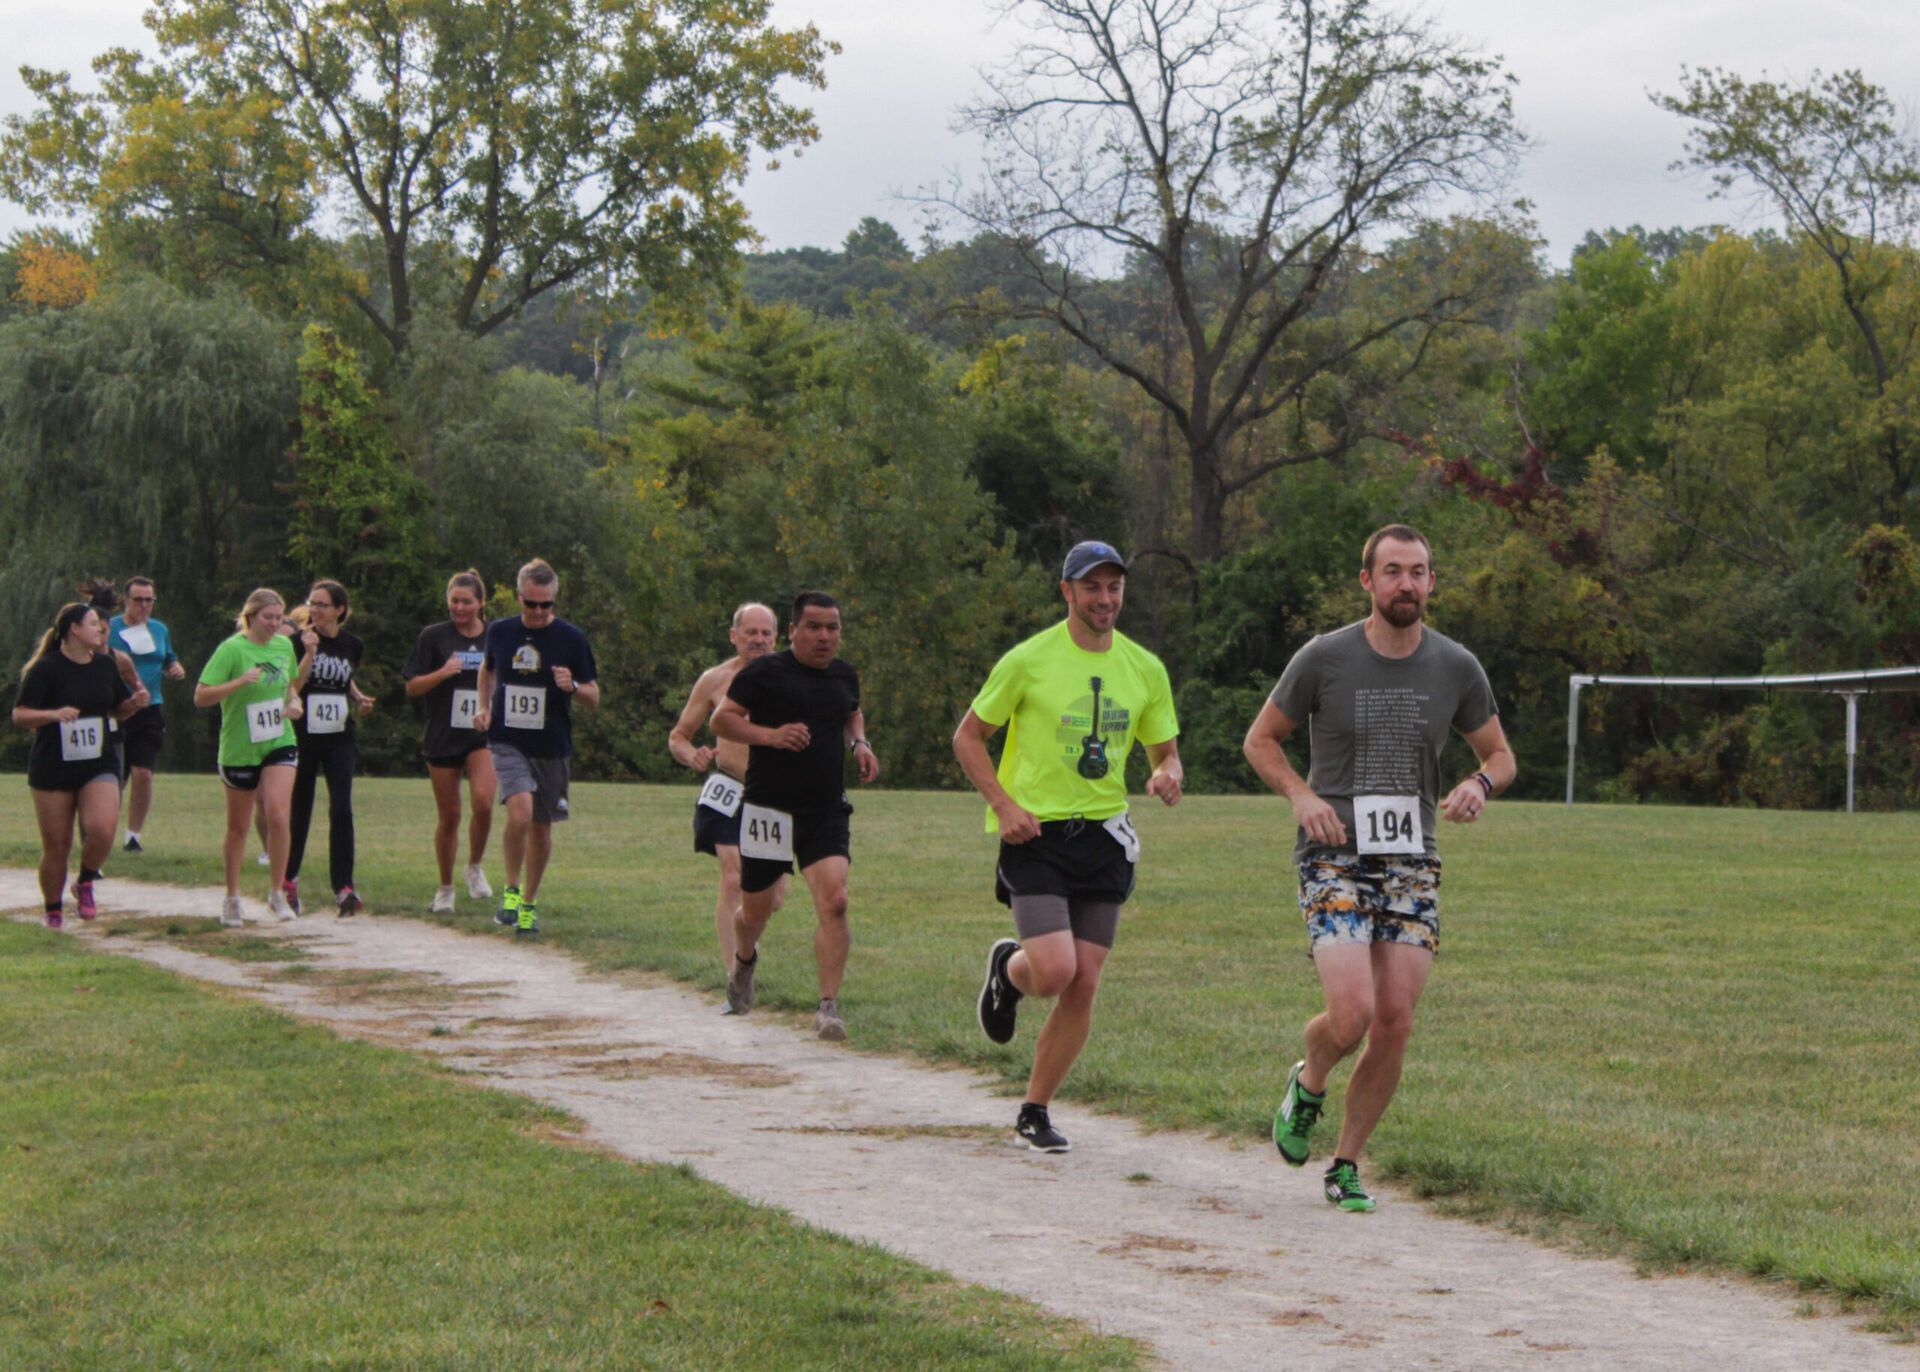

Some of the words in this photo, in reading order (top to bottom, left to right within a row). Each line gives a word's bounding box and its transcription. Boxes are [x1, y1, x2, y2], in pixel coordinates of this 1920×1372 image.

[316, 703, 340, 721] 421
[460, 699, 477, 716] 41
[511, 695, 539, 715] 193
[257, 708, 281, 728] 418
[70, 727, 96, 748] 416
[702, 781, 737, 807] 196
[749, 818, 781, 844] 414
[1366, 810, 1413, 843] 194
